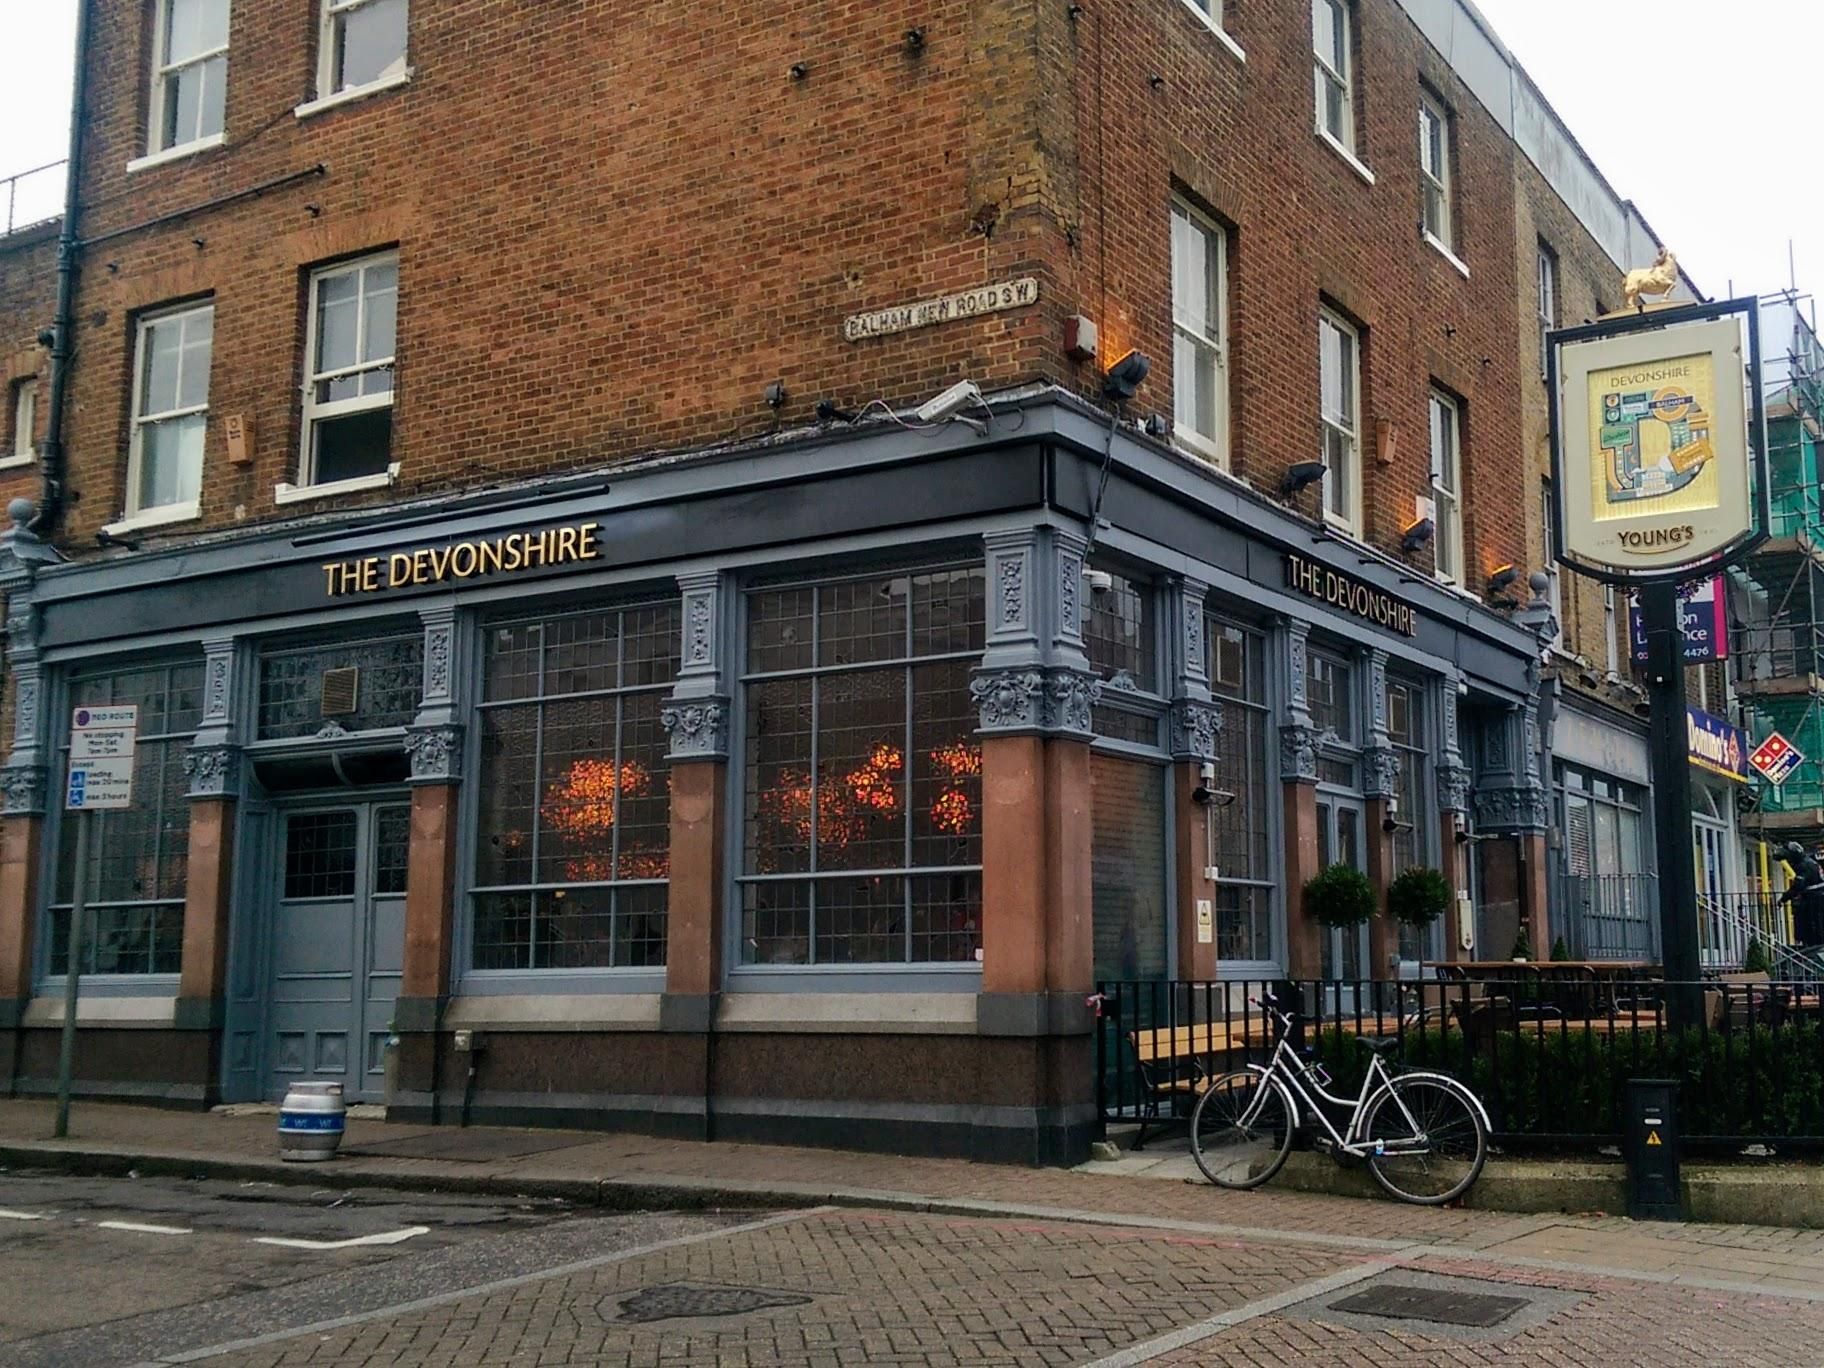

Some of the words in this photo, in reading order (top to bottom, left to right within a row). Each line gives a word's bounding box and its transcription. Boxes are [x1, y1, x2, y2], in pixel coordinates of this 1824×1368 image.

[850, 309, 912, 337] BALHAM
[918, 301, 950, 322] NEW
[957, 291, 998, 313] ROAD
[1611, 366, 1691, 387] DEVONSHIRE
[1618, 525, 1694, 547] YOUNG'S
[322, 557, 379, 596] THE
[389, 523, 598, 587] DEVONSHIRE
[1289, 555, 1322, 597] THE
[1326, 572, 1417, 638] DEVONSHIRE
[1683, 646, 1709, 657] 4476
[109, 712, 134, 720] ROUTE
[1686, 711, 1729, 765] Domino's
